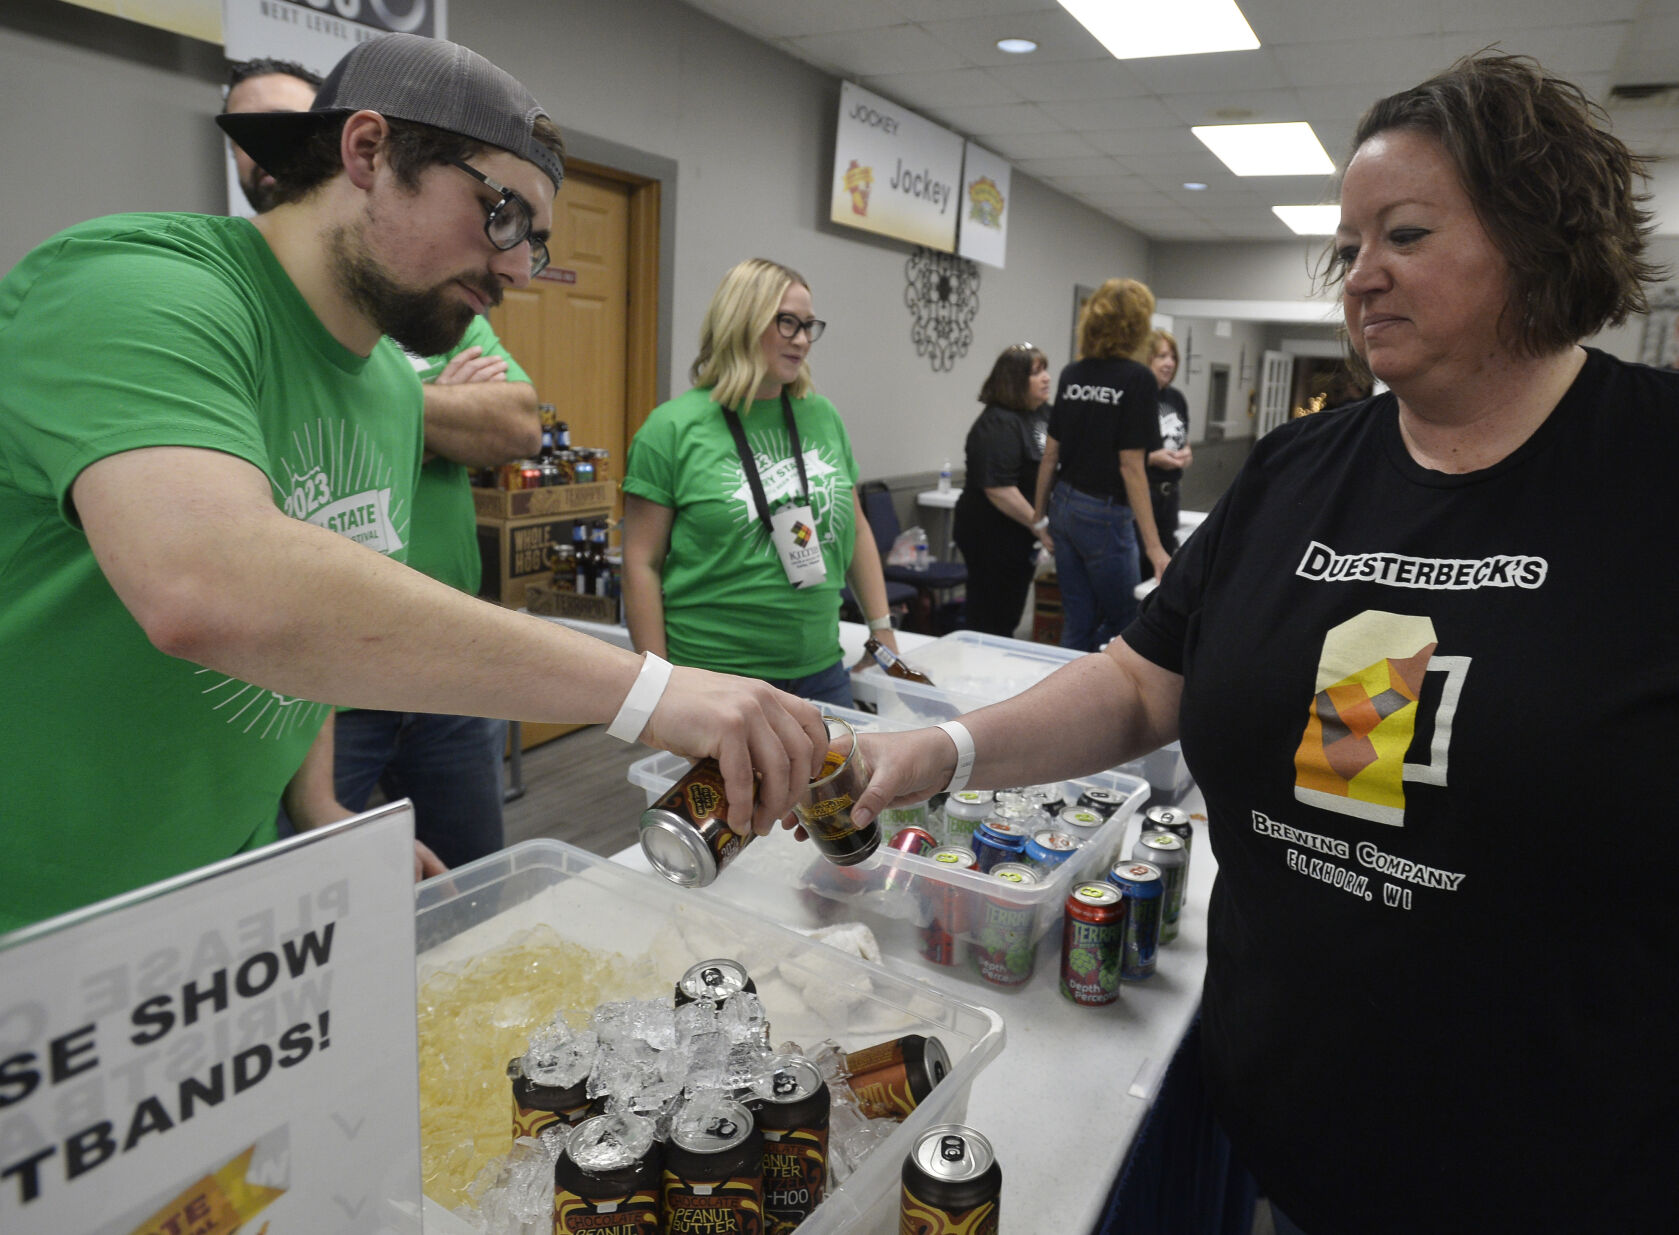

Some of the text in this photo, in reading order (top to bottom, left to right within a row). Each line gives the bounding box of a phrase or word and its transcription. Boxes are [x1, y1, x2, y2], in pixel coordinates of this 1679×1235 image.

[260, 2, 299, 25] NEXT
[305, 13, 348, 39] LEVEL
[849, 103, 899, 136] JOCKEY
[890, 158, 951, 215] Jockey
[1062, 383, 1124, 405] JOCKEY
[1296, 541, 1548, 590] DUESTERBECK'S
[1252, 810, 1466, 891] BREWING COMPANY
[1287, 849, 1412, 910] ELKHORN, WI
[131, 921, 336, 1046] SHOW
[1070, 978, 1101, 994] Depth
[762, 1153, 797, 1168] ANUT
[762, 1165, 803, 1178] TTER
[767, 1189, 809, 1206] -HOO
[566, 1213, 643, 1231] CHOCOLATE
[672, 1218, 739, 1234] BUTTER
[675, 1208, 733, 1224] PEANUT
